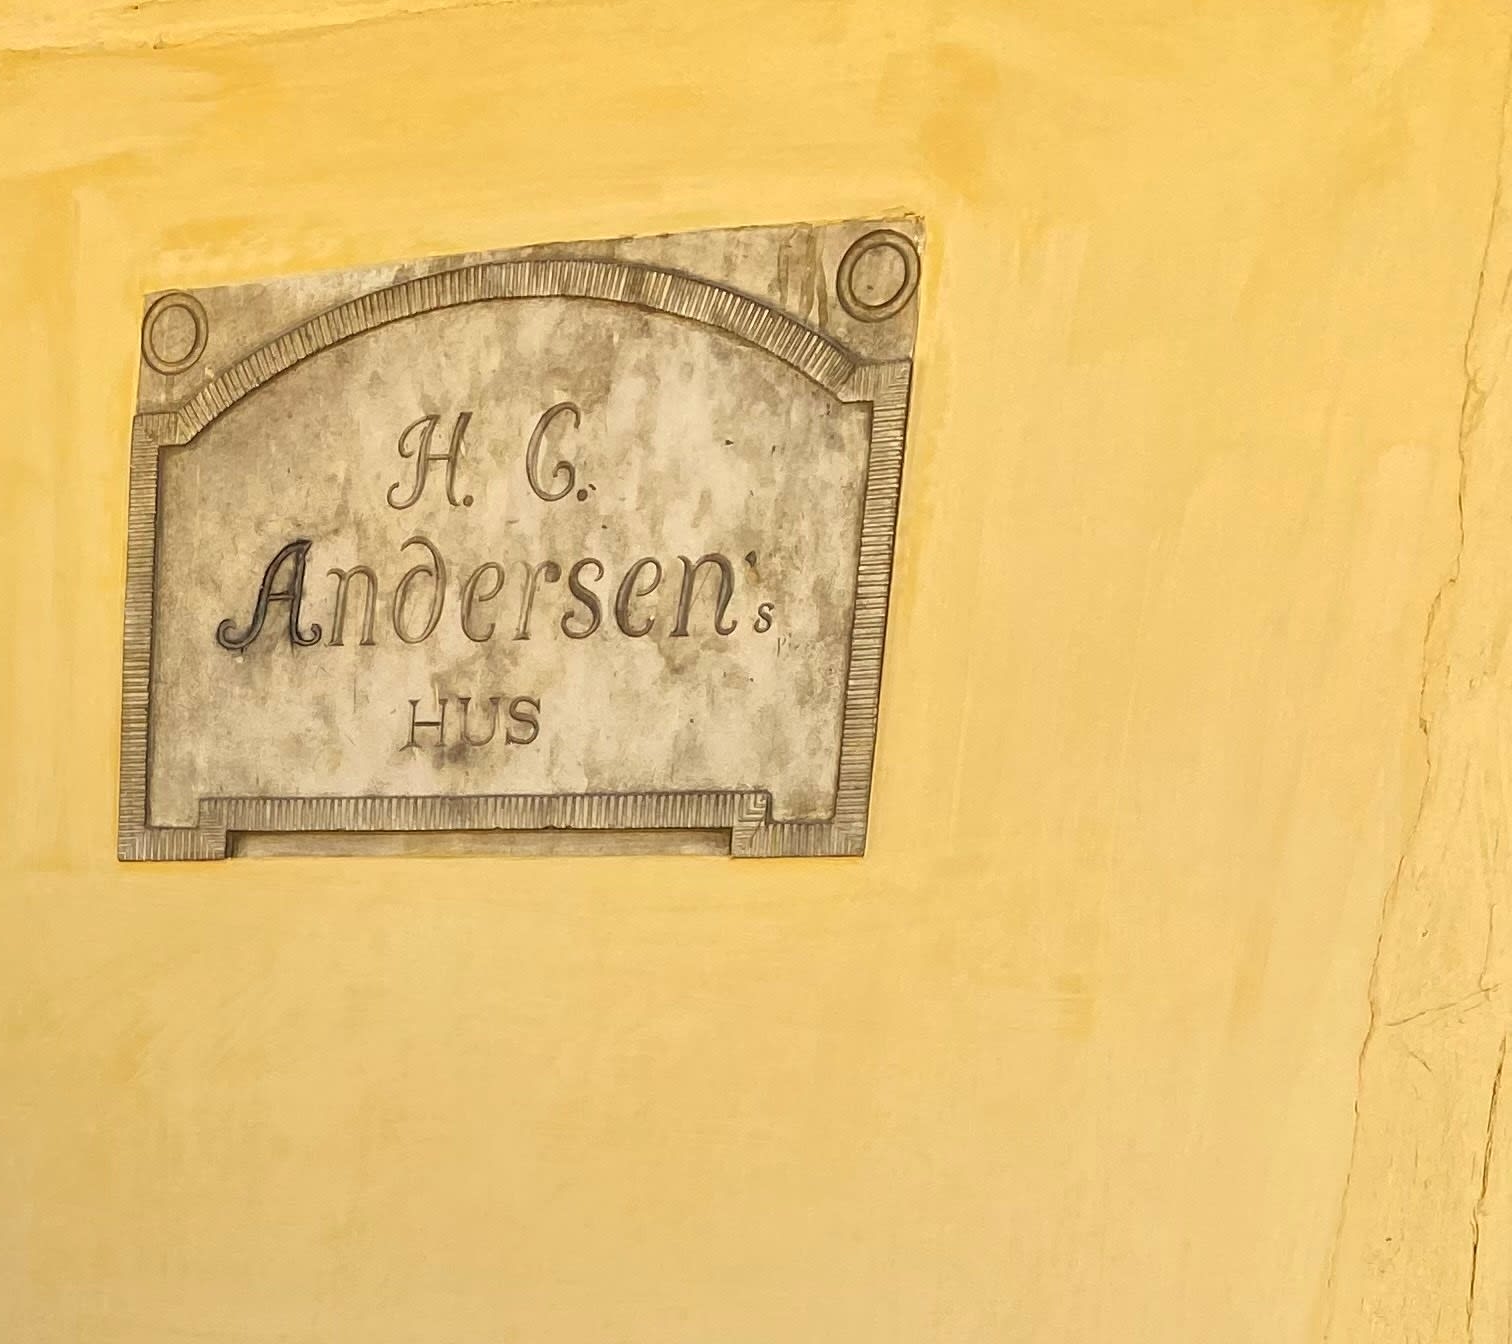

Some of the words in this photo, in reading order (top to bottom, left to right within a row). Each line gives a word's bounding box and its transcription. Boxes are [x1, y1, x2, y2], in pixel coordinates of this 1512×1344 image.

[387, 411, 474, 511] H.
[216, 536, 775, 652] Andersen's
[400, 695, 541, 752] HUS
